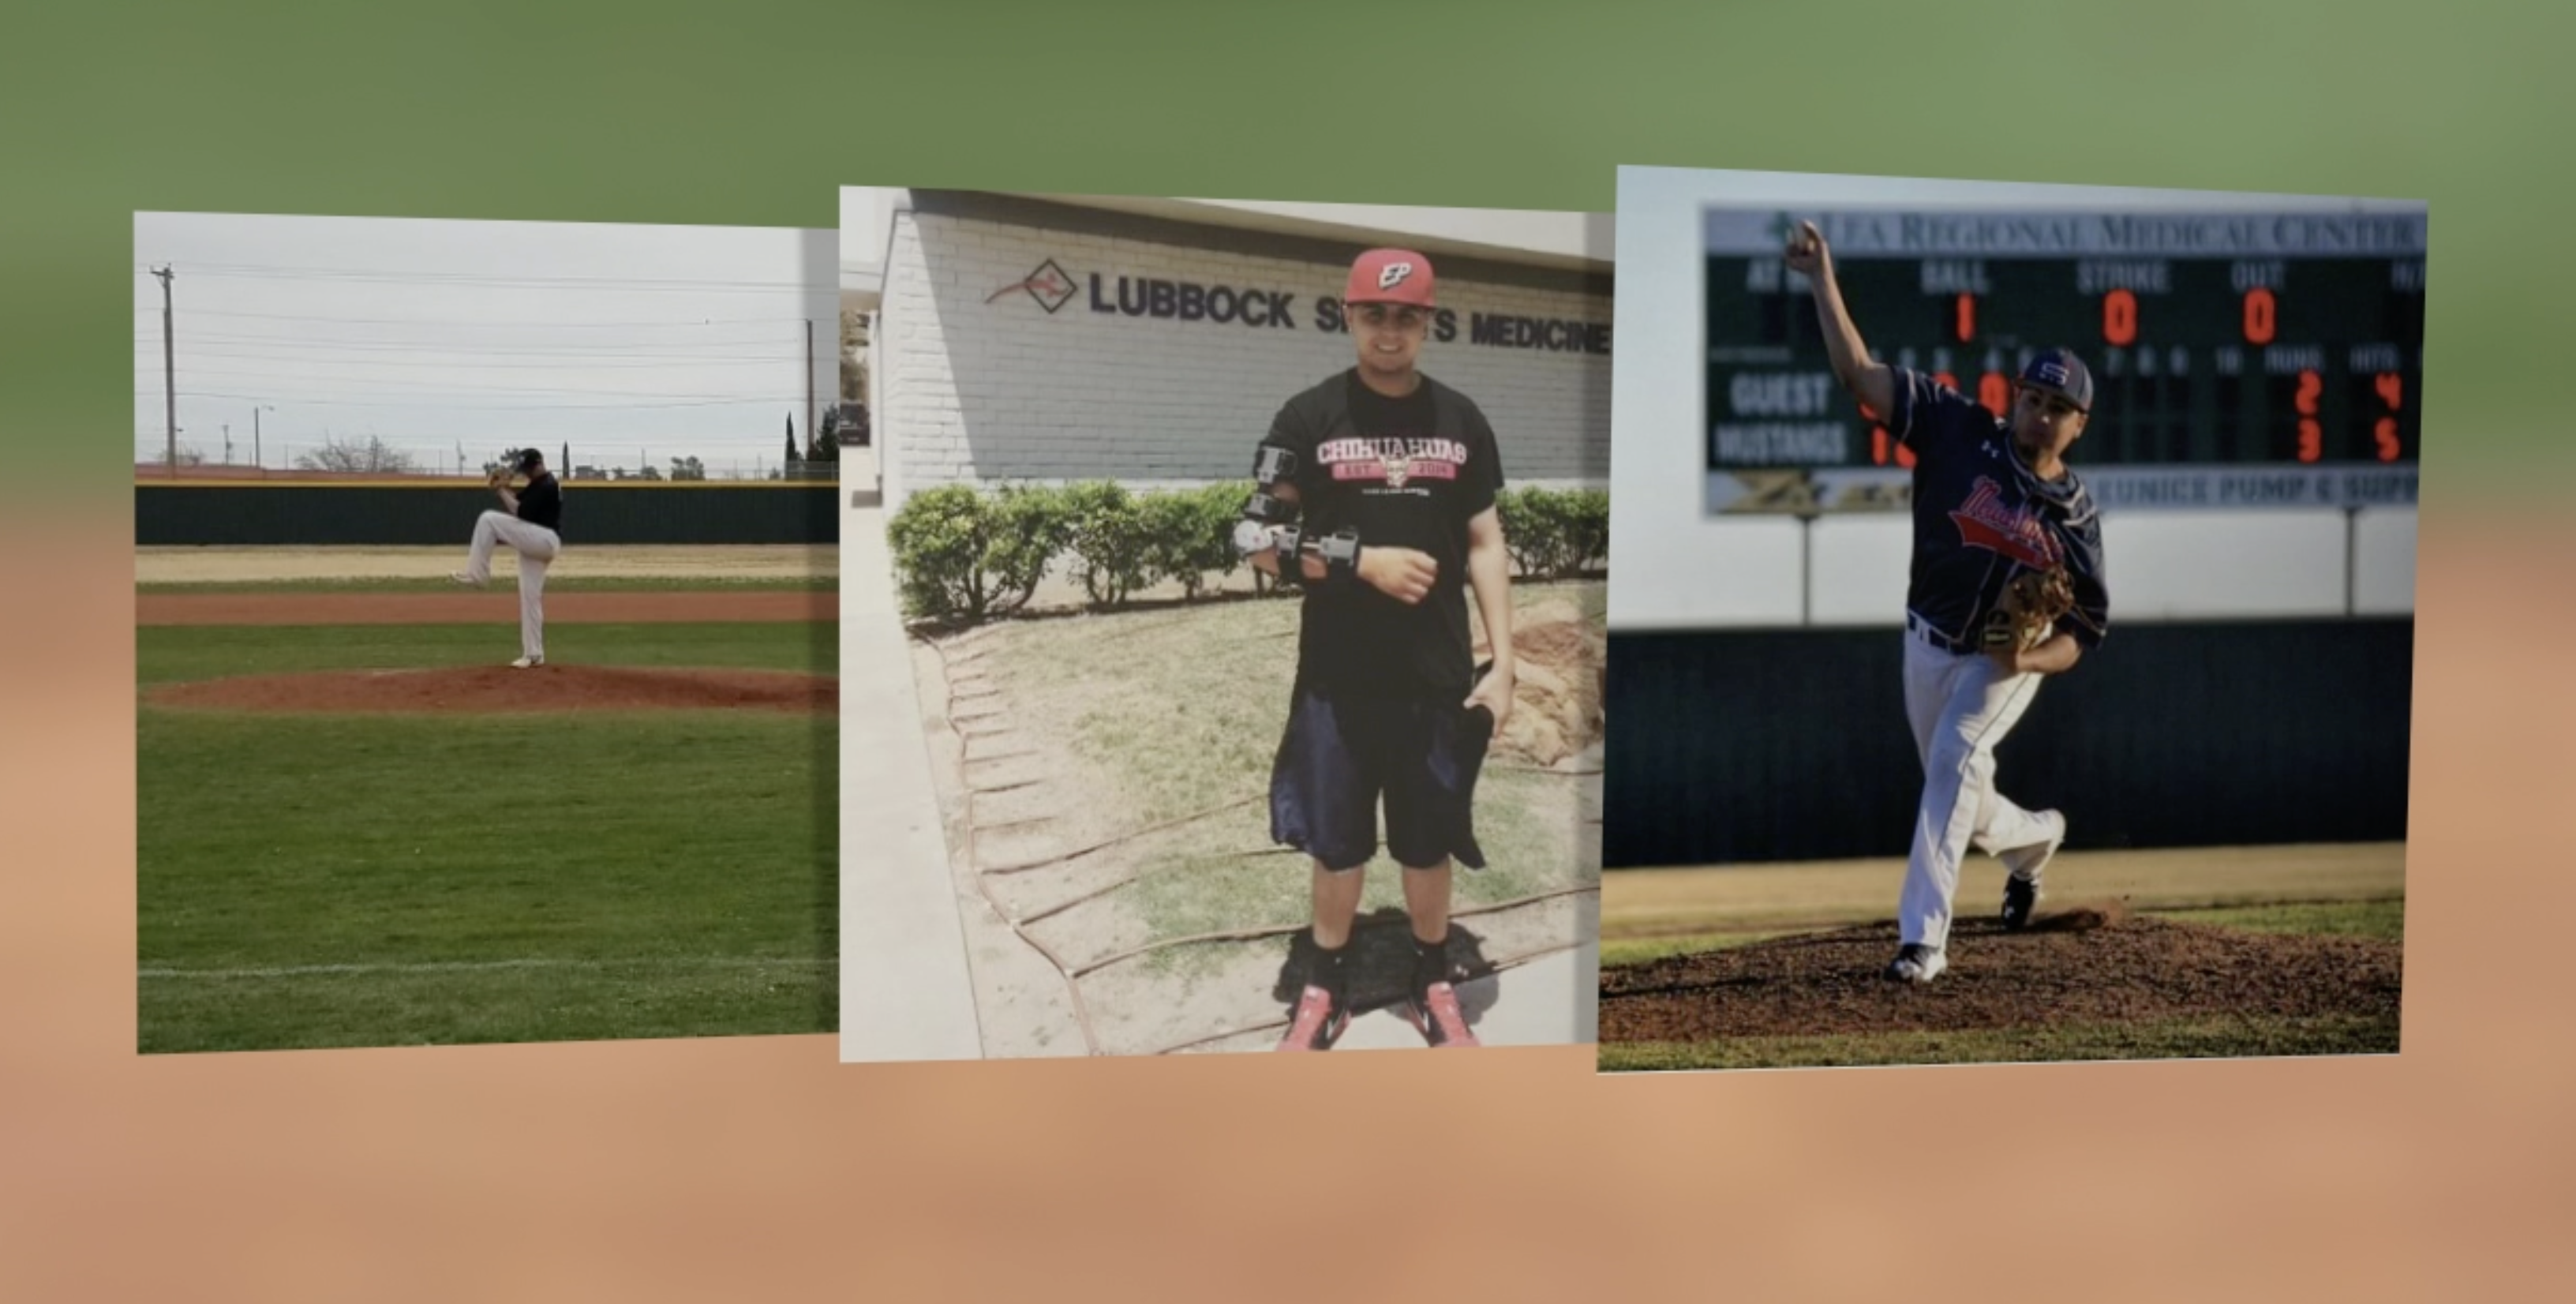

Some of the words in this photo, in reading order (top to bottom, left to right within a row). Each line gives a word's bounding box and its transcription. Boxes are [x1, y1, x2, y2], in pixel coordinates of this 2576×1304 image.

[1901, 212, 2079, 249] REGIONAL
[2099, 214, 2259, 249] MEDICAL
[2273, 213, 2416, 250] CENTER
[1921, 260, 1990, 294] BALL
[2077, 261, 2171, 294] STRIKE
[2231, 261, 2284, 294] OUT
[1090, 272, 1296, 328] LUBBOCK
[1471, 312, 1612, 354] MEDICINE
[1956, 291, 1975, 343] 1
[2102, 288, 2138, 346] 0
[2243, 287, 2276, 345] 0
[1731, 373, 1831, 416] GUEST
[2296, 370, 2321, 414] 2
[2376, 372, 2401, 411] 4
[1317, 437, 1467, 464] CHIHUAHUAS
[1715, 422, 1848, 463] MUSTANGS
[2297, 418, 2322, 463] 3
[2375, 417, 2400, 463] 5
[2097, 477, 2208, 502] EUNICE
[2219, 477, 2307, 503] PUMP
